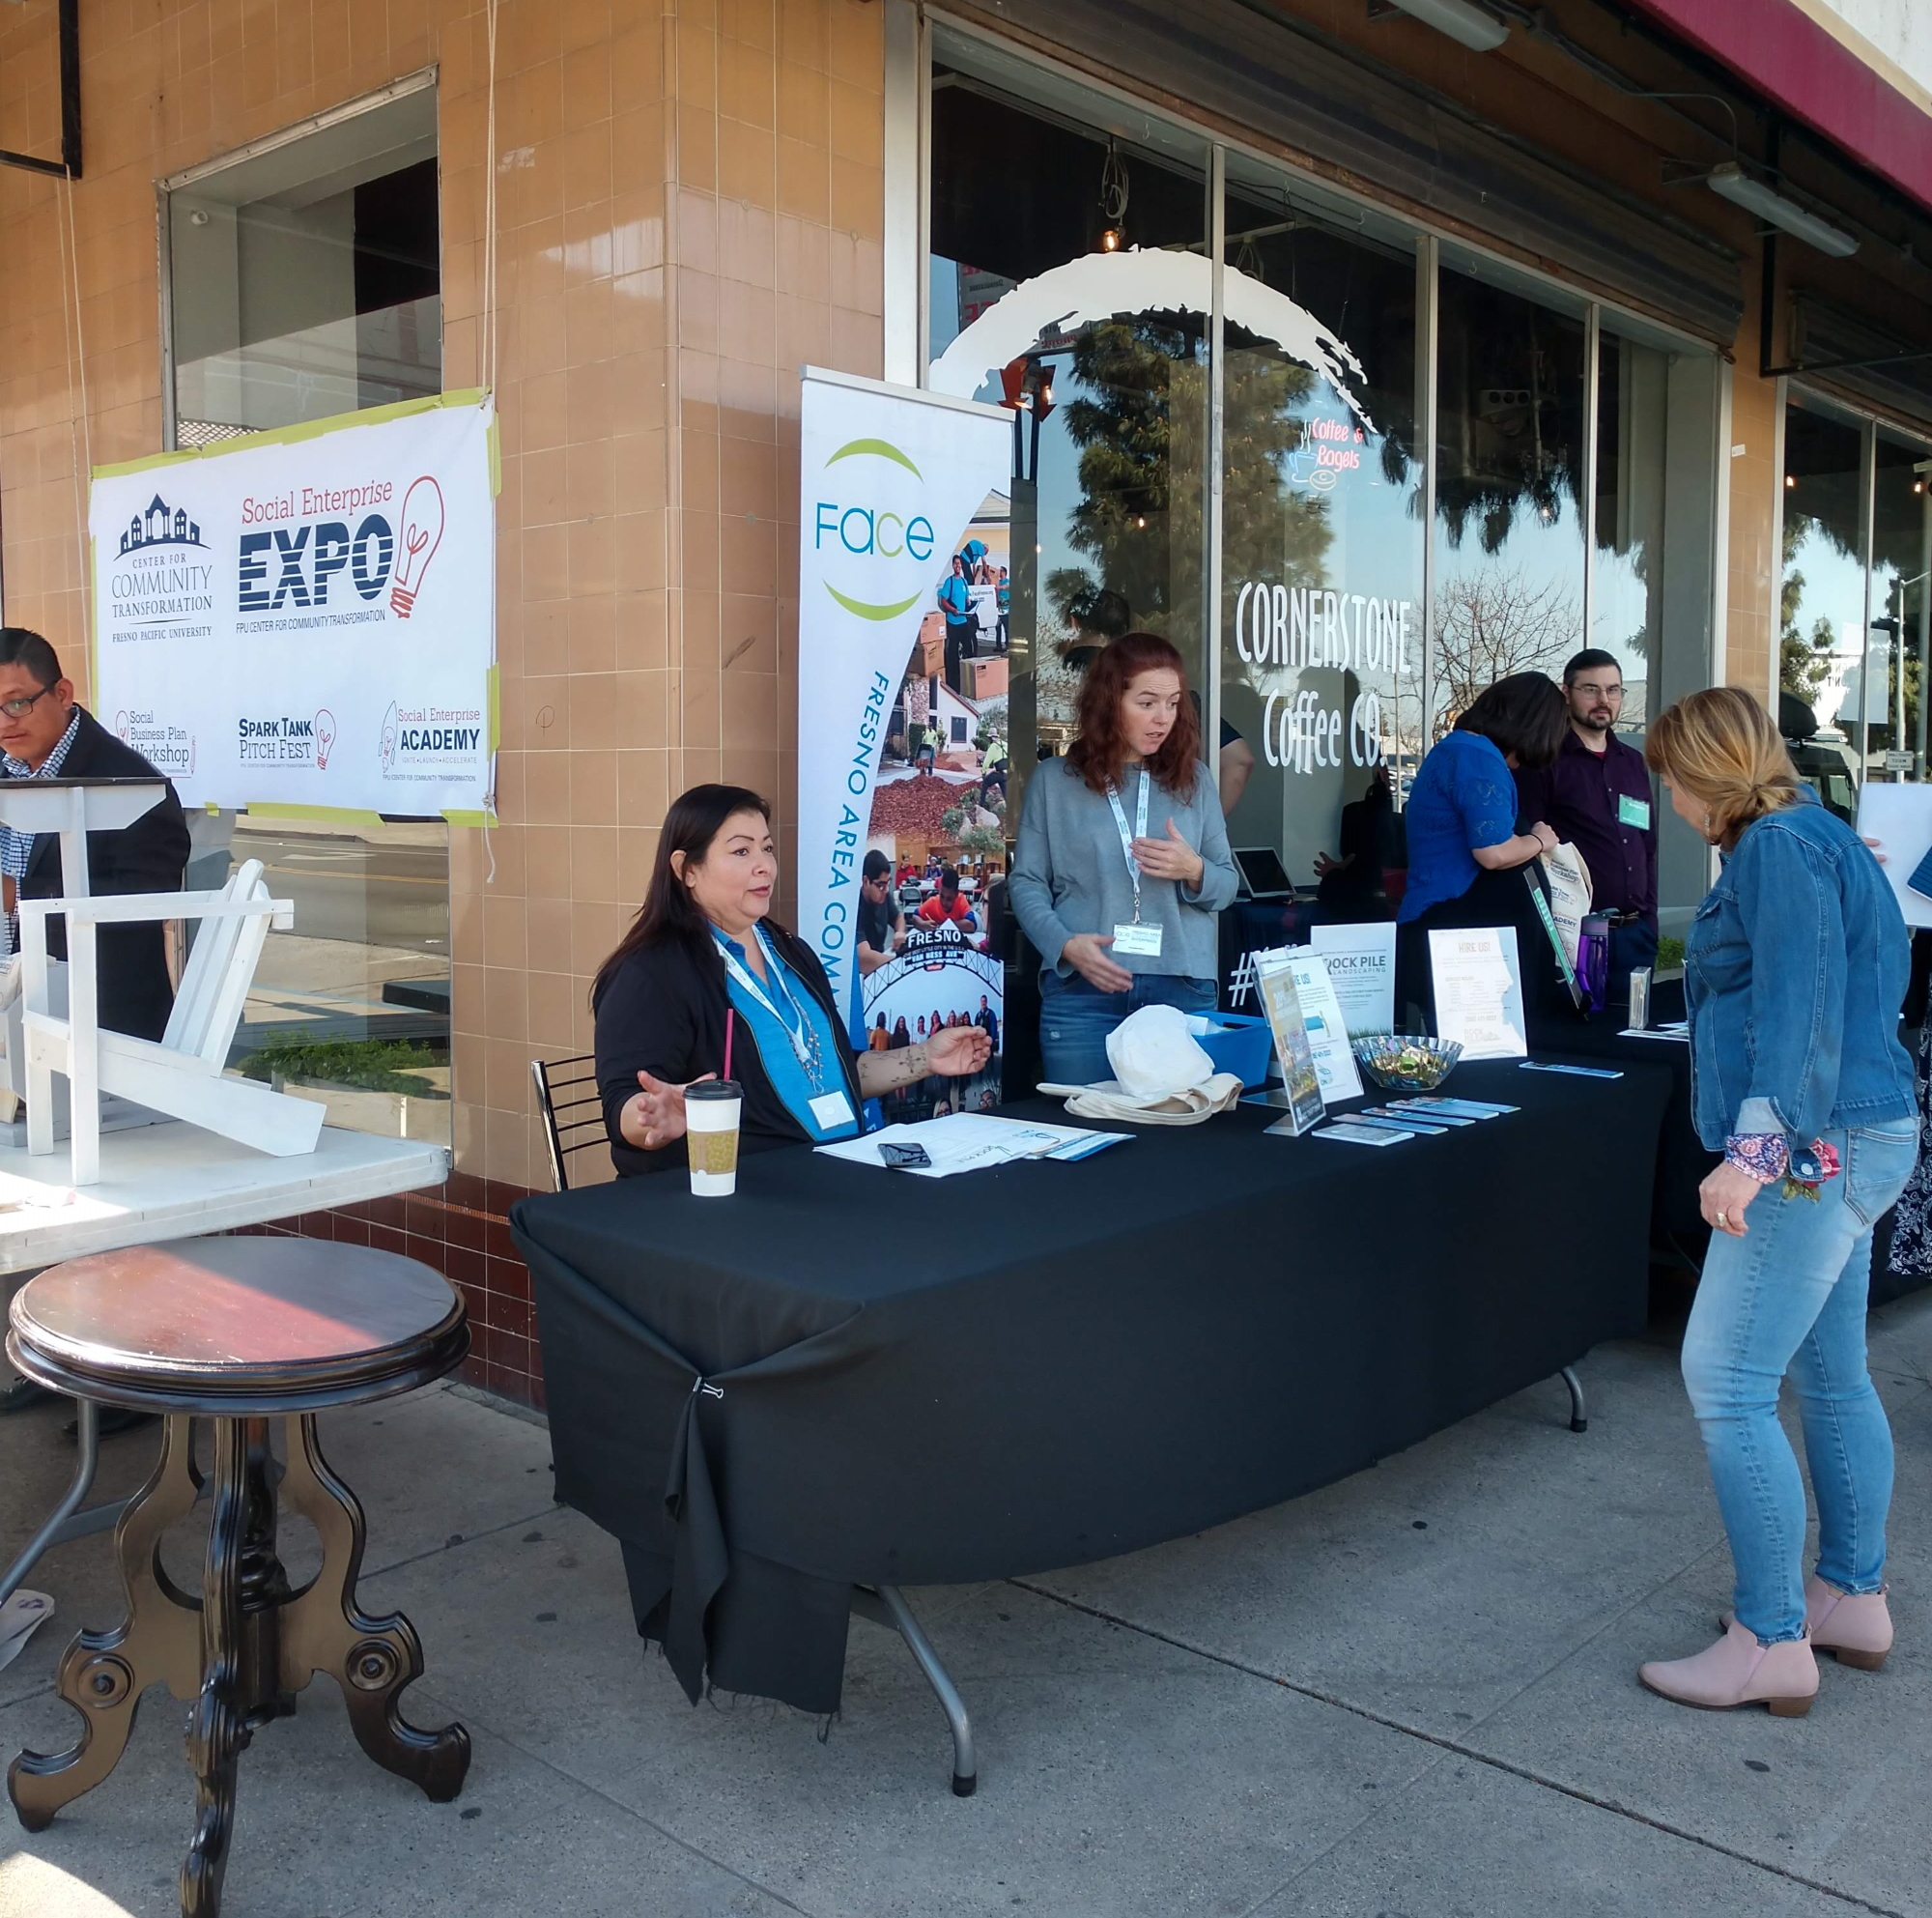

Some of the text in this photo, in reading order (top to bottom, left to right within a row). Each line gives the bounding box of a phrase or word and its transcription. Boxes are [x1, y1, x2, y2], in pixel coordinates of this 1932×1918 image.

[1312, 417, 1350, 443] Coffee
[1318, 444, 1360, 472] Bagels
[242, 479, 393, 525] Social Enterprise
[815, 501, 935, 561] Face
[132, 553, 186, 569] CENTER FOR
[239, 513, 394, 613] EXPO
[111, 564, 213, 599] COMMUNITY
[111, 595, 213, 618] TRANSFORMATION
[236, 609, 386, 634] FPU CENTER FOR COMMUNITY TRANSFORMATION
[1236, 581, 1411, 673] CORNERSTONE
[112, 626, 213, 644] FRESNO PACIFIC UNIVERSITY
[129, 709, 154, 724] Social
[239, 717, 314, 737] SPARK TANK
[398, 707, 480, 725] Social Enterprise
[130, 727, 187, 741] Business Plan
[400, 728, 480, 751] ACADEMY
[846, 670, 890, 796] FRESNO
[1264, 688, 1342, 775] Coffee
[240, 738, 311, 759] PITCH FEST
[828, 803, 861, 890] AREA
[1553, 916, 1577, 927] ADEMY
[907, 930, 962, 949] FRESNO
[820, 901, 847, 1009] COM
[1360, 956, 1386, 967] PILE
[1333, 967, 1386, 976] LANDSCAPING
